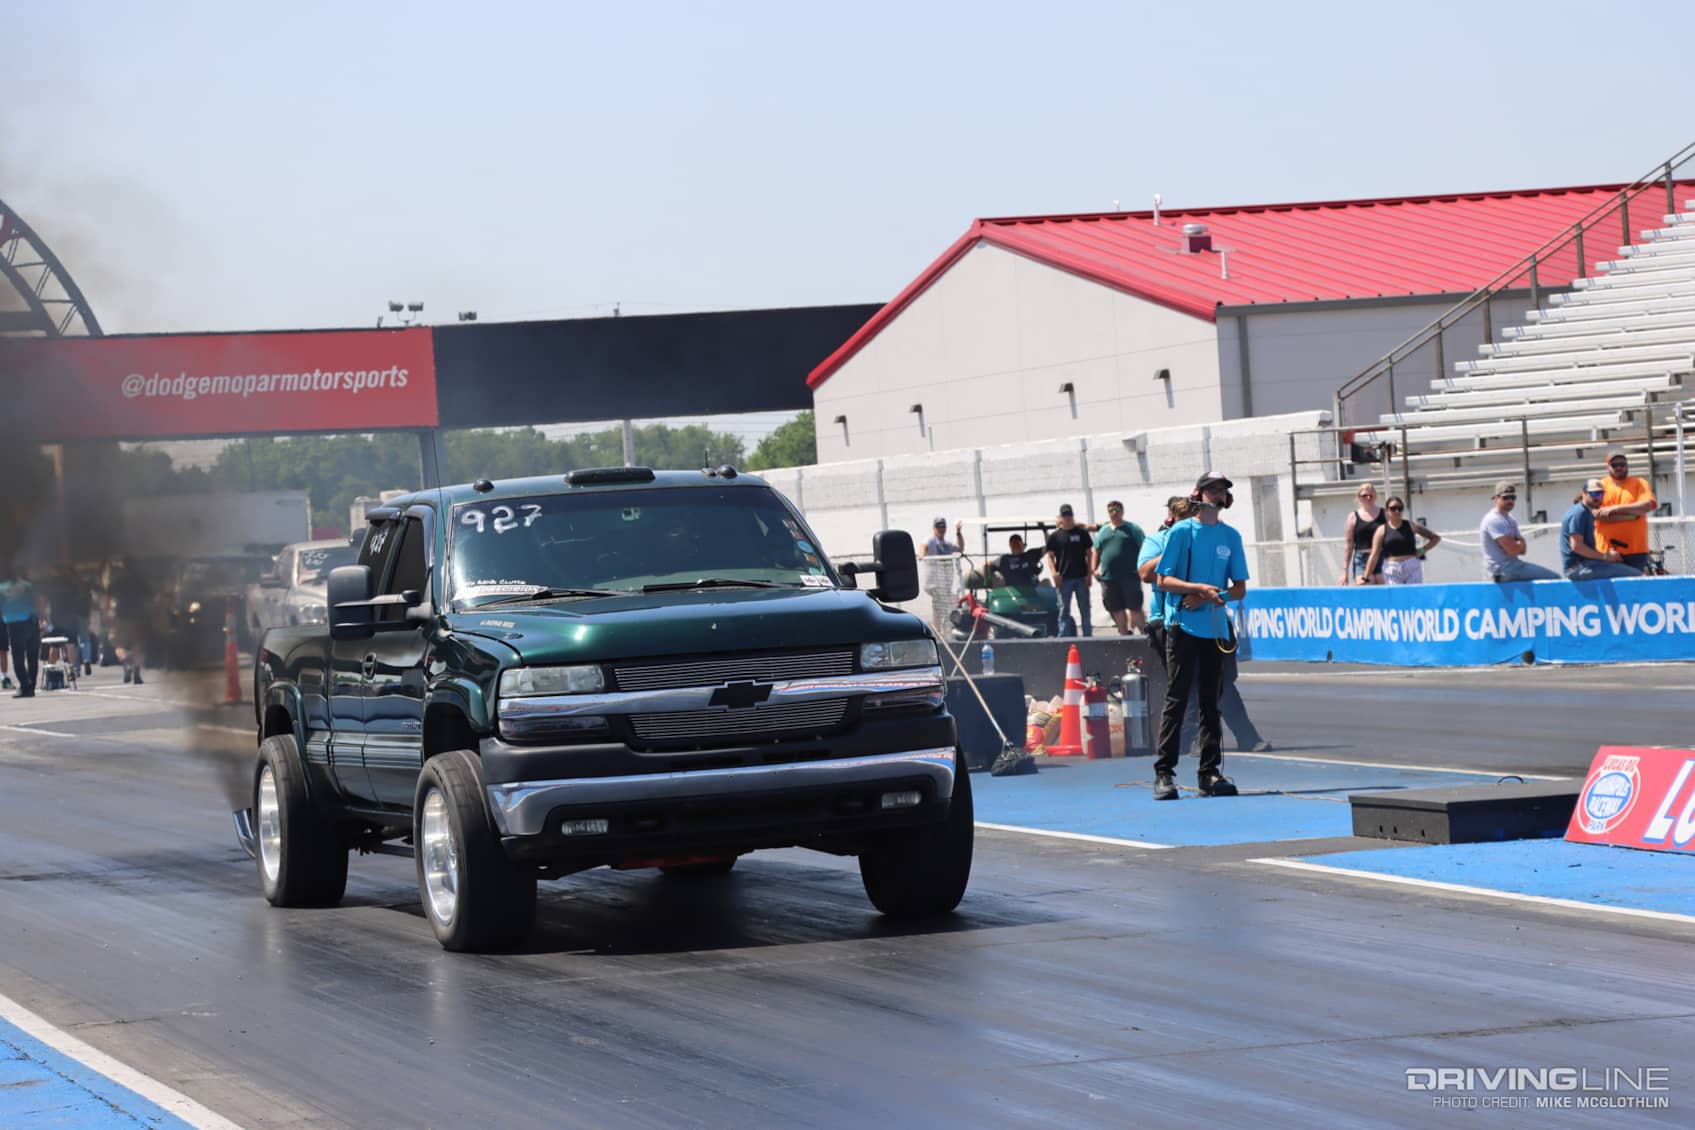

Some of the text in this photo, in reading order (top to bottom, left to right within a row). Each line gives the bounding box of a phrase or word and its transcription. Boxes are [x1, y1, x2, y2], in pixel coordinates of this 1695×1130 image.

[121, 365, 409, 399] @dodgemoparmotorsports
[461, 504, 543, 534] 927
[1283, 607, 1333, 638] WORLD
[1335, 607, 1399, 642] CAMPING
[1400, 608, 1459, 642] WORLD
[1465, 604, 1601, 640] CAMPING
